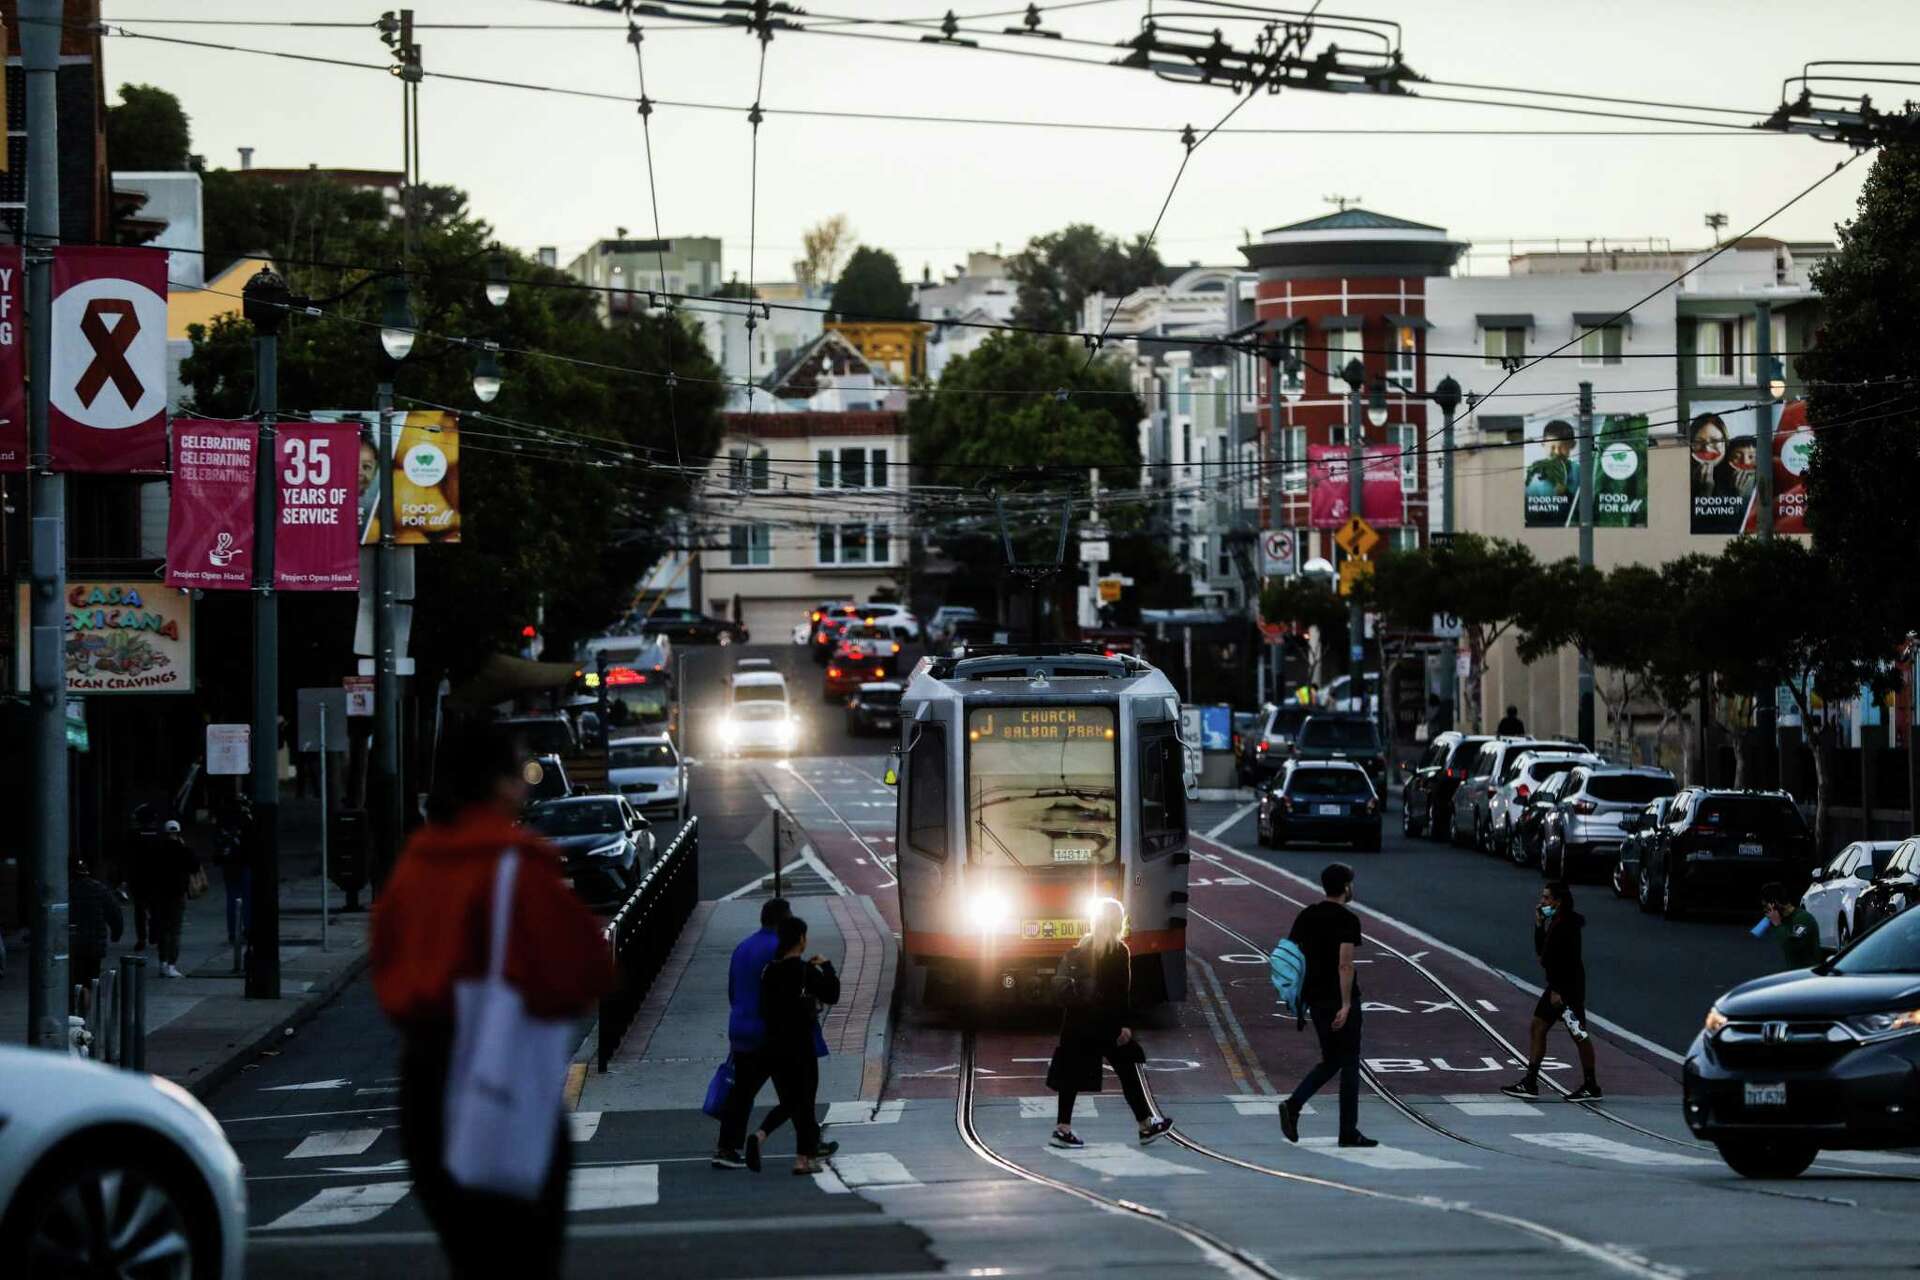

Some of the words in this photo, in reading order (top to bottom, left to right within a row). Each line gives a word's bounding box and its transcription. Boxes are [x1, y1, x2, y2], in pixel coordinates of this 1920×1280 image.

[181, 435, 251, 451] CELEBRATING
[180, 451, 250, 467] CELEBRATING
[284, 438, 330, 485] 35
[180, 467, 249, 482] CELEBRATING
[282, 488, 326, 504] YEARS
[330, 488, 347, 504] OF
[1552, 496, 1568, 504] FOR
[1599, 493, 1628, 503] FOOD
[1695, 497, 1722, 505] FOOD
[1724, 497, 1742, 505] FOR
[402, 504, 435, 513] FOOD
[1528, 504, 1559, 512] HEALTH
[1599, 503, 1619, 512] FOR
[1620, 499, 1642, 513] all
[1695, 506, 1735, 515] PLAYING
[1779, 506, 1803, 516] FOR
[282, 508, 339, 525] SERVICE
[402, 515, 426, 526] FOR
[429, 510, 454, 525] all
[173, 569, 200, 580] Project
[201, 570, 221, 581] Open
[223, 572, 245, 581] Hand
[281, 573, 308, 583] Project
[309, 574, 330, 584] Open
[332, 574, 352, 583] Hand
[68, 584, 144, 609] CASA
[64, 609, 180, 642] EXICANA
[107, 671, 177, 690] CRAVINGS
[1022, 710, 1076, 723] CHURCH
[980, 714, 993, 735] J
[1004, 726, 1057, 737] BALBOA
[1067, 725, 1104, 737] PARK
[1363, 1056, 1573, 1073] BUS
